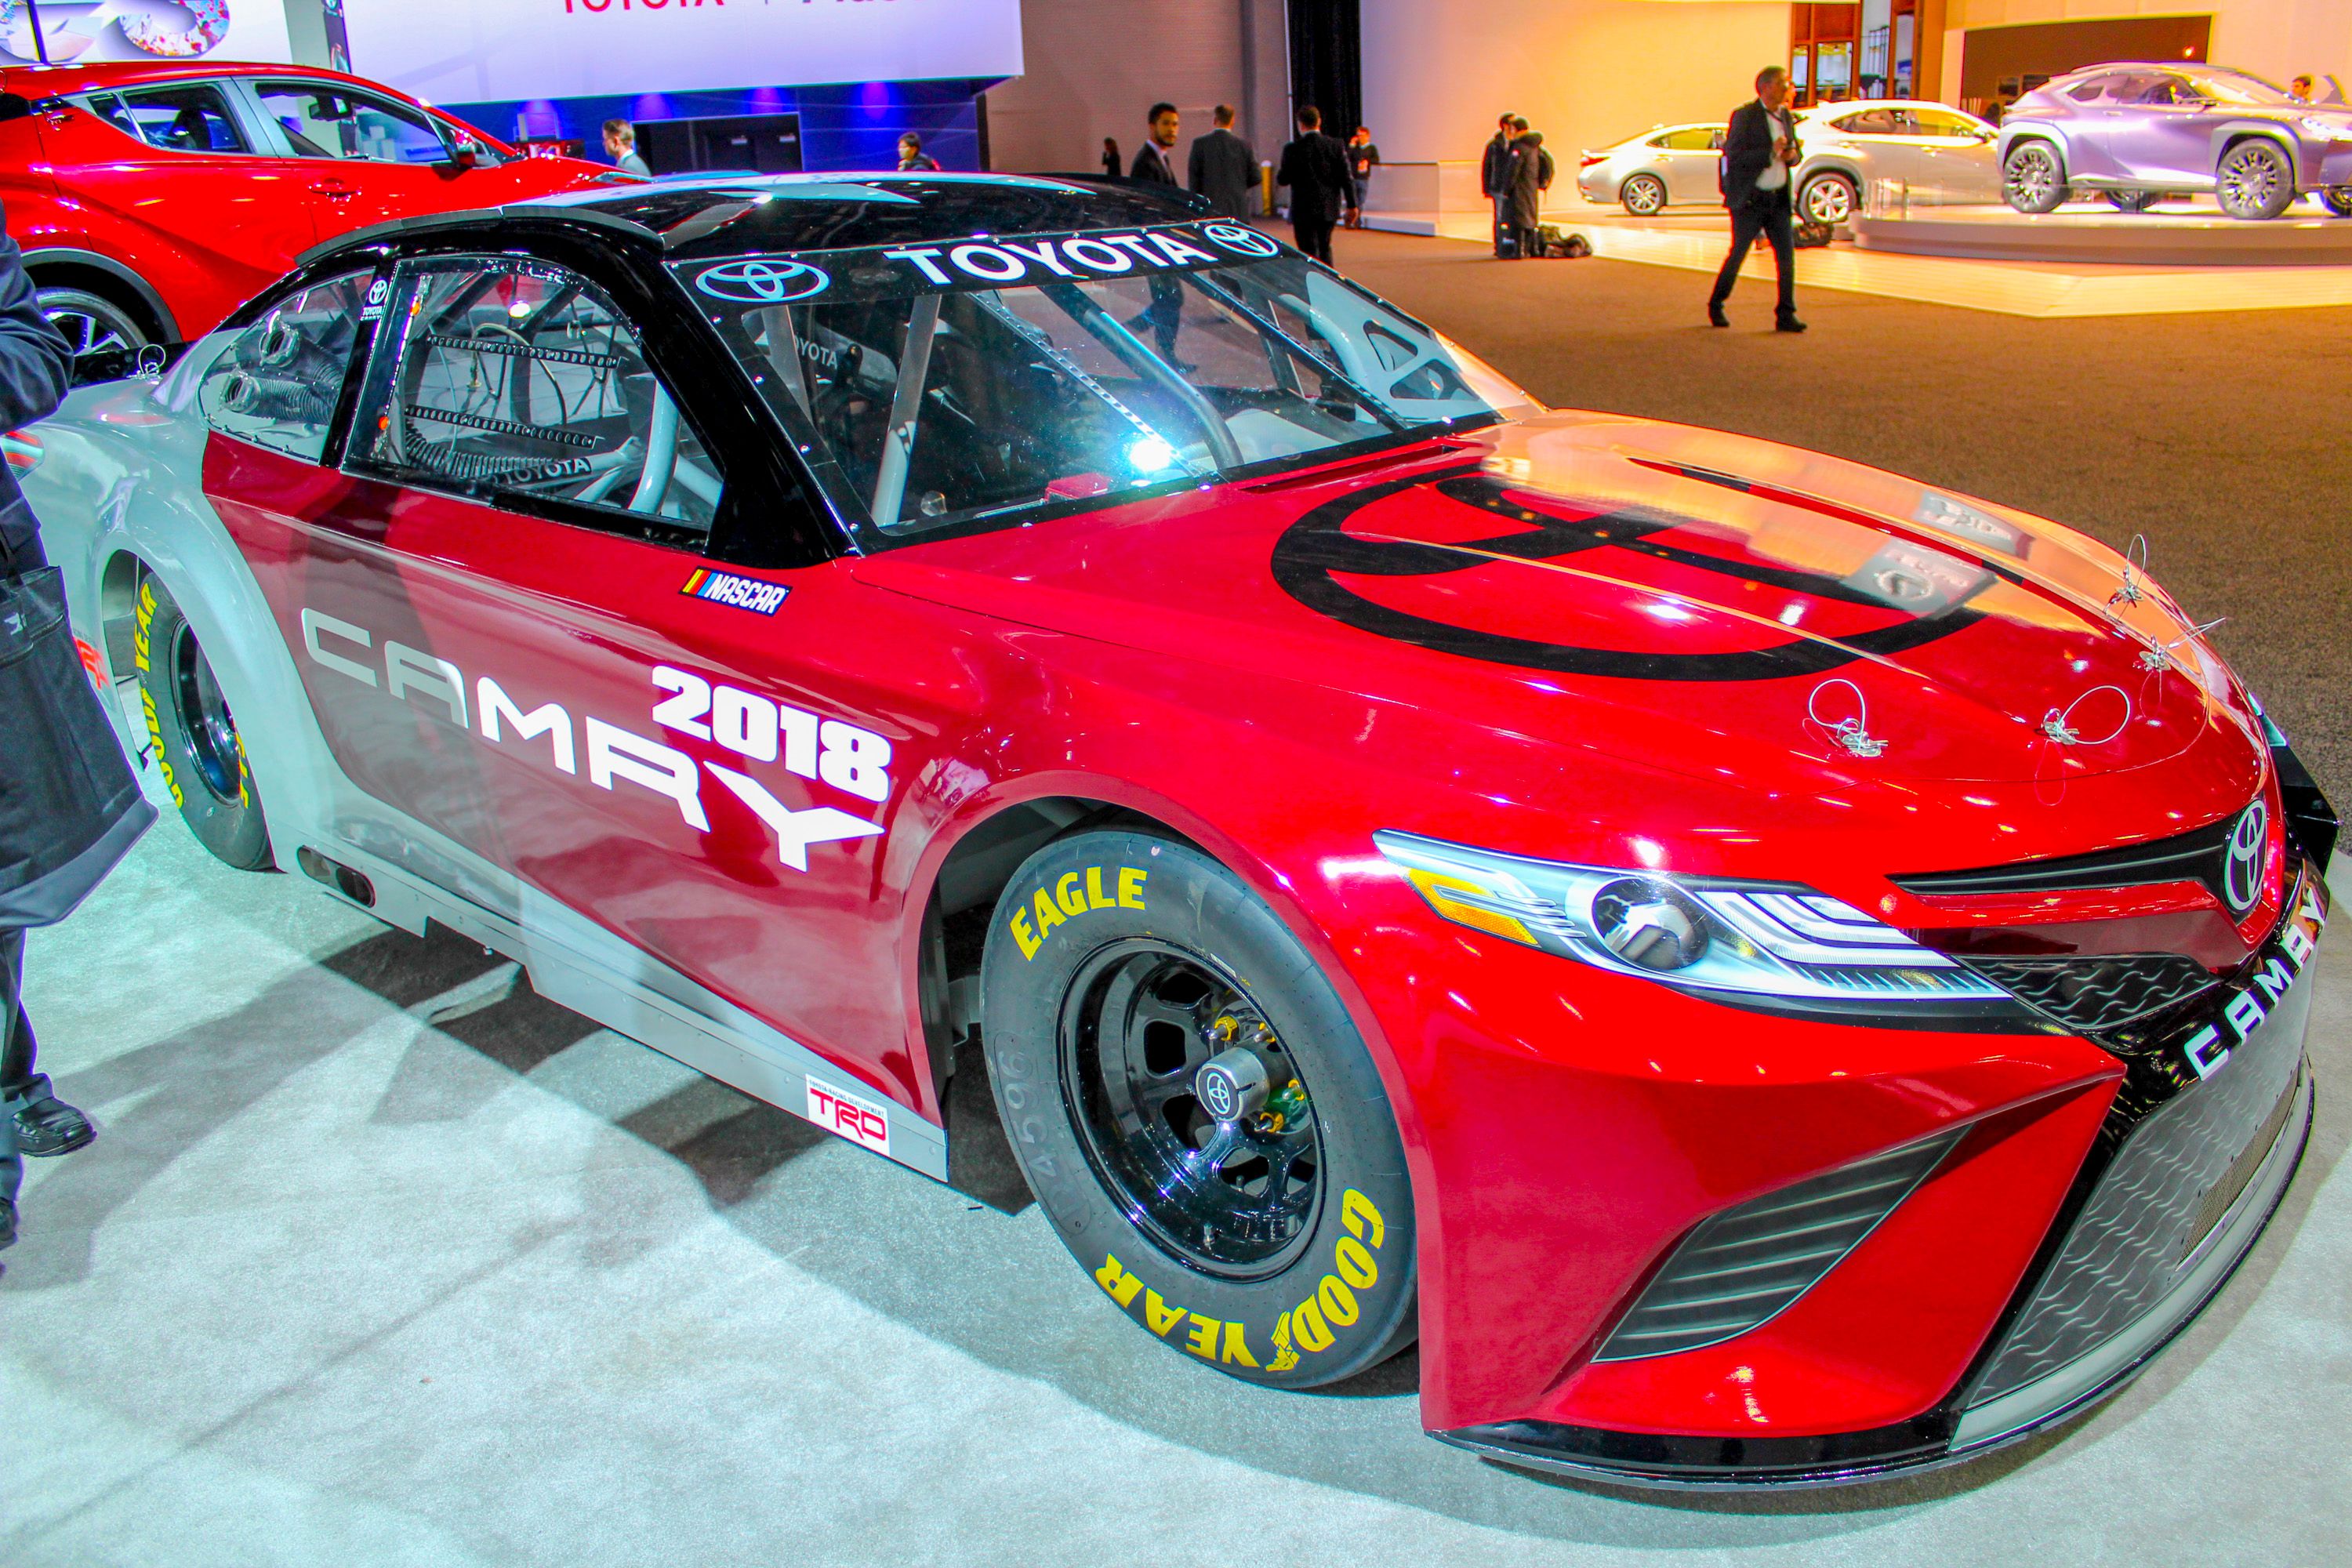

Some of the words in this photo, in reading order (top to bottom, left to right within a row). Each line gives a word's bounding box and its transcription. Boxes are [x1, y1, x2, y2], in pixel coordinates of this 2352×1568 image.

[883, 233, 1218, 285] TOYOTA
[704, 574, 786, 614] NASCAR
[301, 608, 884, 872] CAMRY
[652, 665, 891, 802] 2018
[1009, 866, 1148, 961] EAGLE
[2184, 887, 2327, 1080] CAMRY
[810, 1087, 886, 1141] TRD
